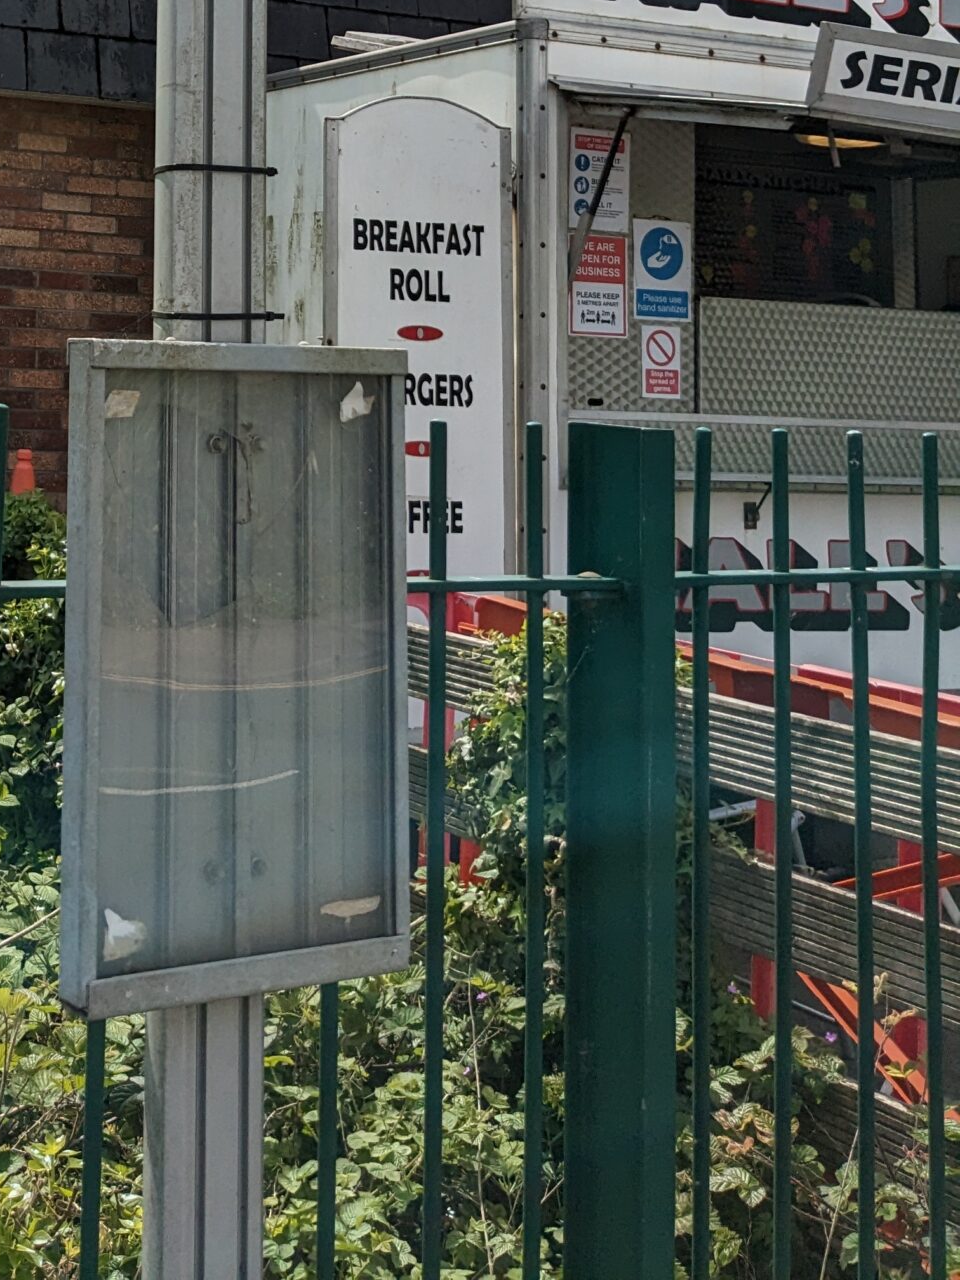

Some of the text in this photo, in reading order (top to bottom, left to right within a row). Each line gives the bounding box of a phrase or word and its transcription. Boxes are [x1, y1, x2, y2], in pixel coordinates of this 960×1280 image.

[840, 51, 960, 106] SERI
[352, 217, 485, 257] BREAKFAST
[597, 242, 615, 252] ARE
[581, 253, 621, 265] PEN FOR
[575, 265, 621, 277] BUSINESS
[389, 268, 451, 303] ROLL
[576, 291, 620, 300] PLEASE KEEP
[643, 293, 682, 304] Please use
[637, 302, 687, 314] hand sanitizer
[650, 370, 663, 378] Stop
